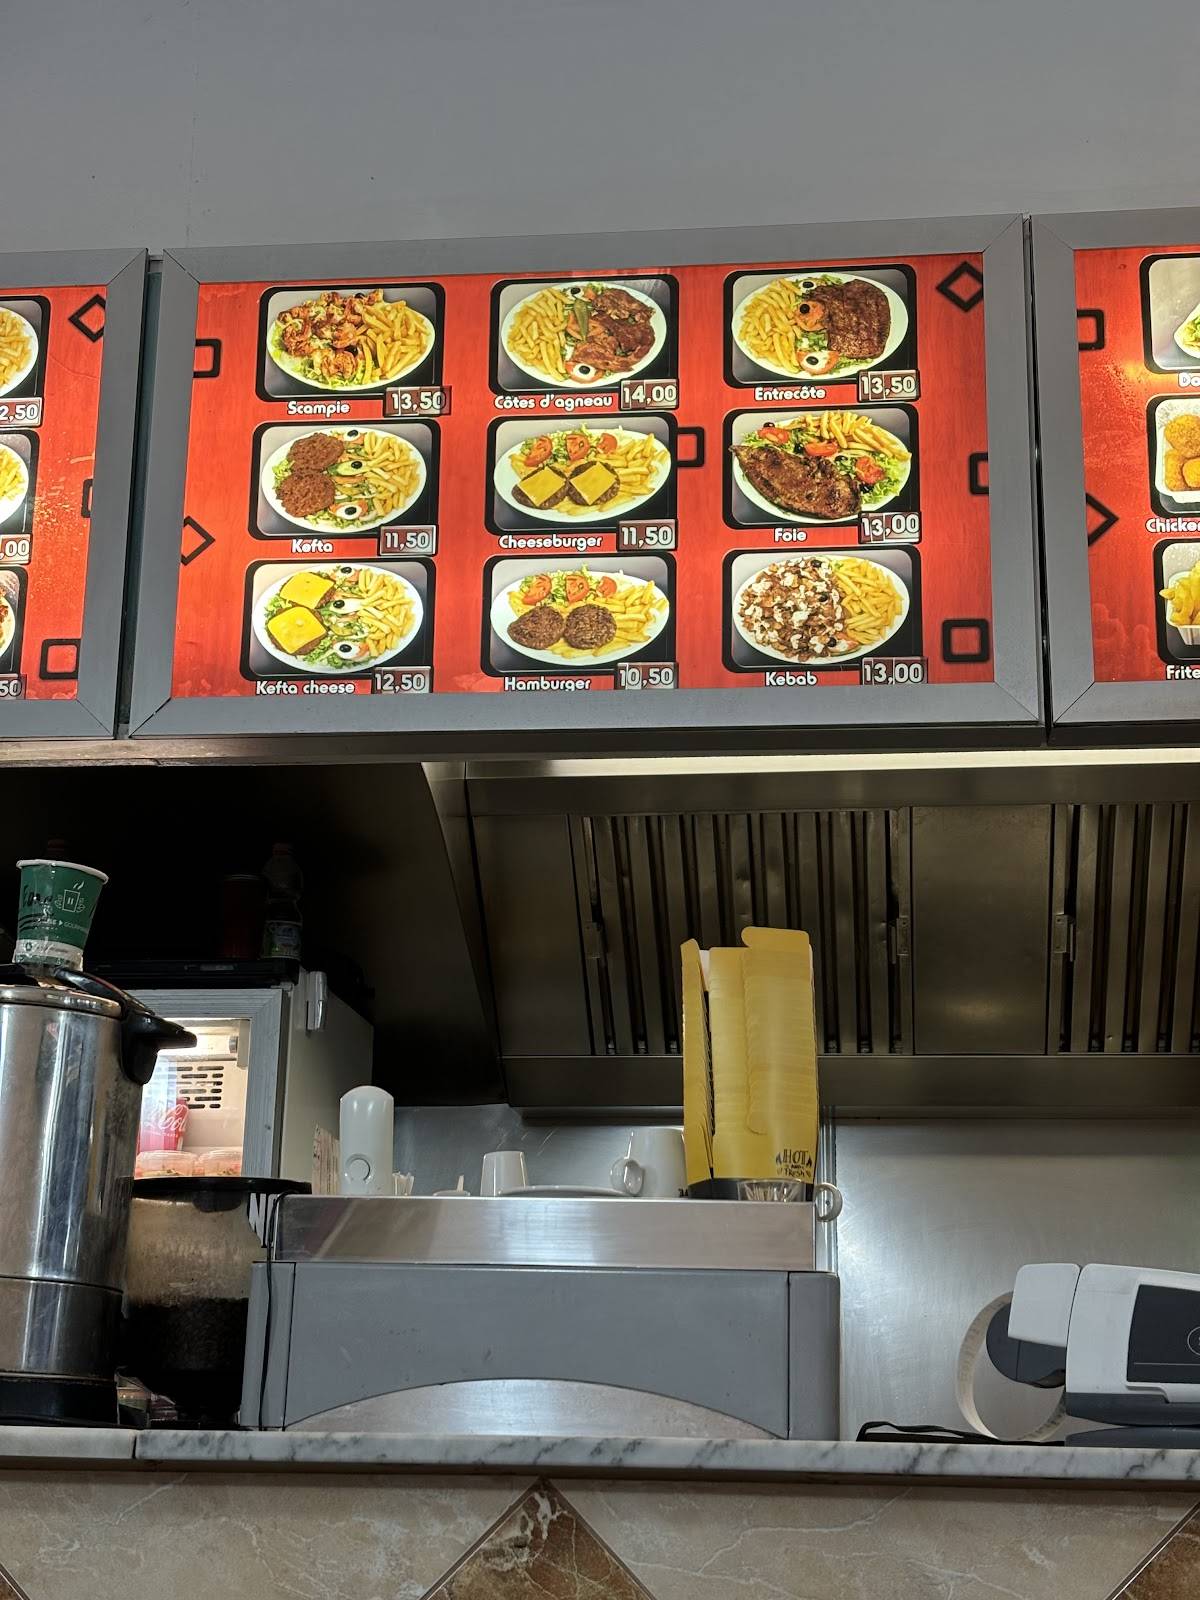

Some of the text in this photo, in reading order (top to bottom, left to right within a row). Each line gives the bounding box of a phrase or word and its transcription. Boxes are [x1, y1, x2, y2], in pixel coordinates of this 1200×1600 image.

[623, 385, 677, 404] 14,00
[754, 386, 826, 401] Entrecôte
[861, 376, 916, 396] 13,50
[287, 399, 351, 418] Scampie
[391, 391, 447, 411] 13,50
[494, 394, 614, 412] Côtes d'agneau
[861, 513, 920, 537] 13,00
[1145, 516, 1200, 533] Chicke
[385, 532, 431, 551] 11,50
[499, 534, 603, 551] Cheeseburger
[621, 526, 673, 548] 11,50
[774, 528, 807, 542] Foie
[291, 538, 334, 553] Kefta
[374, 673, 426, 693] 12,50
[619, 667, 674, 687] 10,50
[765, 671, 818, 686] Kebab
[864, 663, 924, 685] 13,00
[256, 680, 355, 695] Kefta cheese
[504, 676, 591, 692] Hamburger
[783, 1148, 809, 1165] HOT
